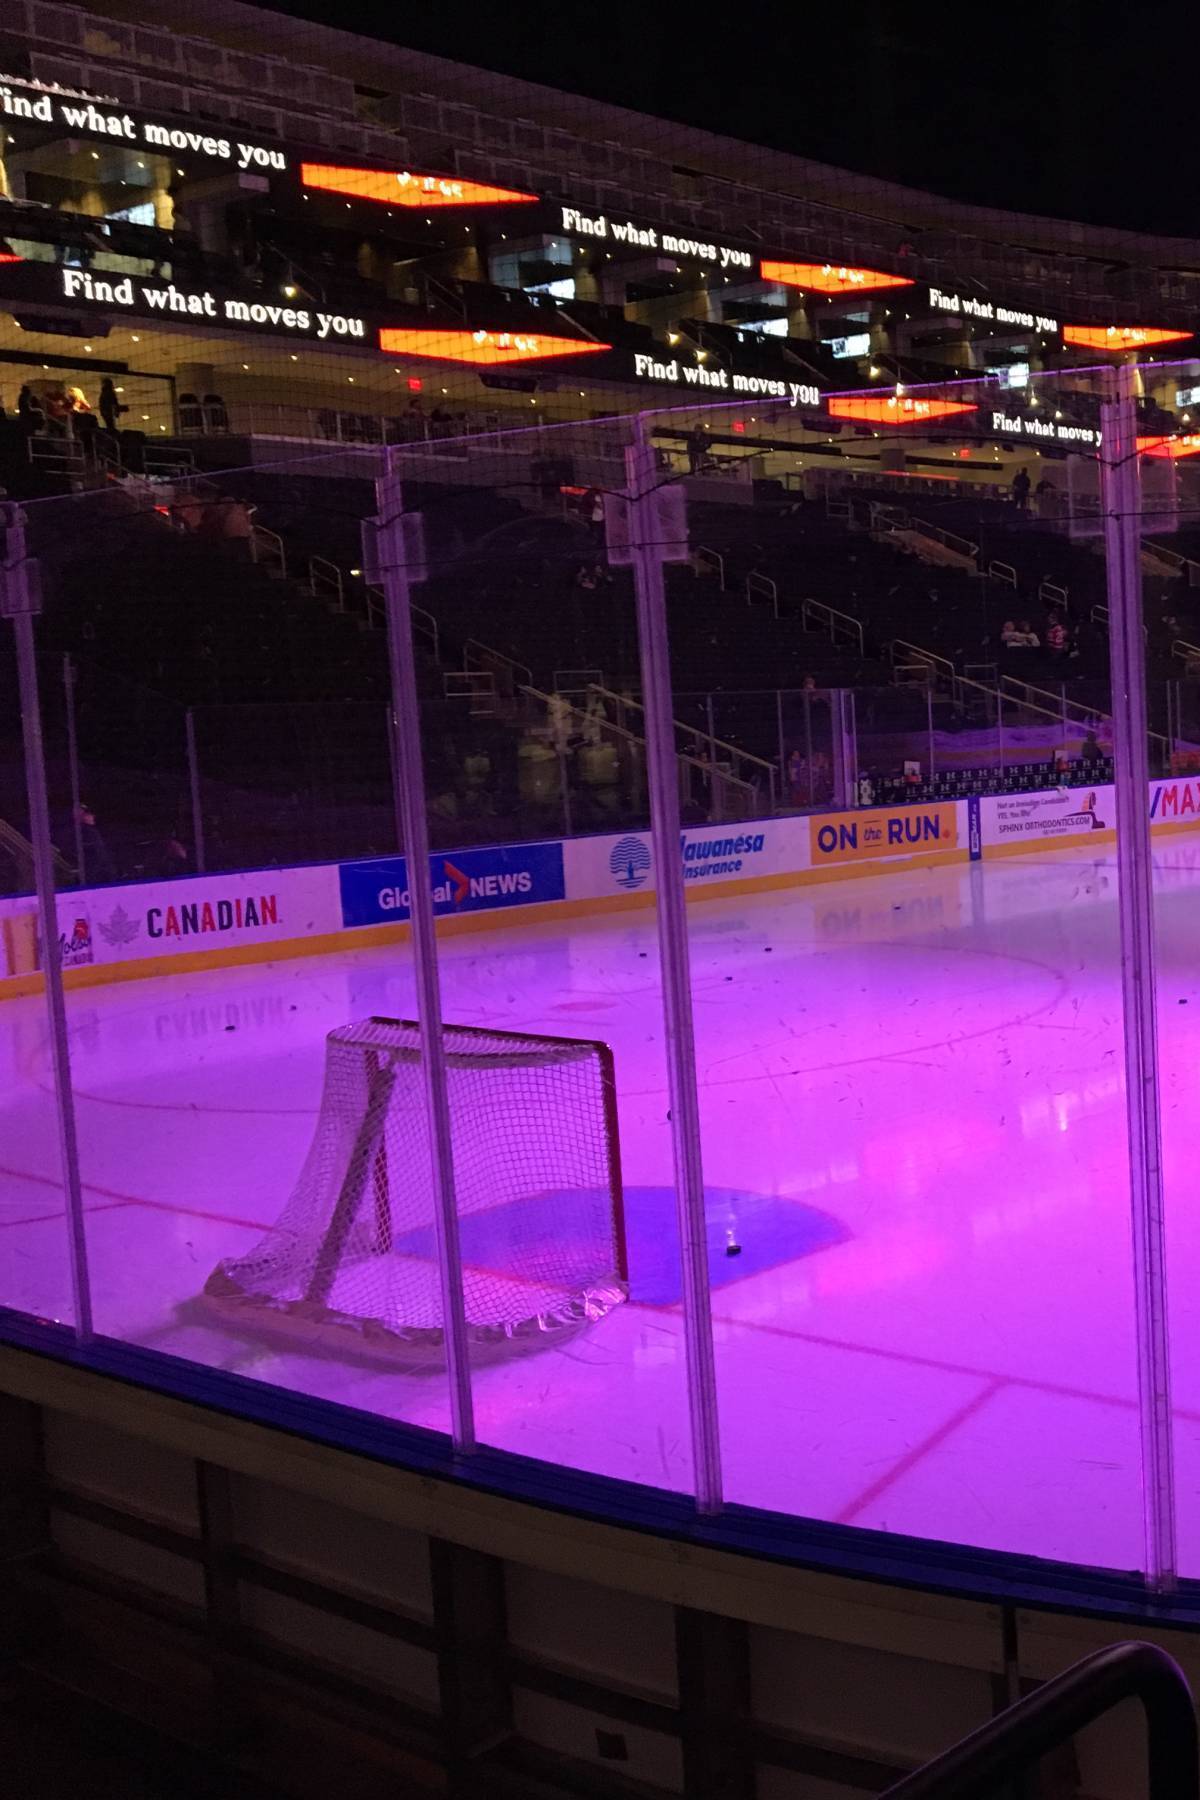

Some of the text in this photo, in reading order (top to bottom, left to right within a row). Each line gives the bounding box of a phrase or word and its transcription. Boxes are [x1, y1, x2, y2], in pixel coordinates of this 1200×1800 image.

[0, 86, 286, 169] ind what moves you
[562, 207, 751, 267] Find what moves you
[63, 269, 364, 338] Find what moves you
[930, 288, 1057, 333] Find what moves you
[635, 354, 820, 407] Find what moves you
[993, 413, 1021, 432] Find
[1024, 419, 1055, 437] what
[1058, 426, 1093, 442] moves
[681, 834, 765, 862] awanesa
[818, 823, 857, 853] ON
[864, 828, 882, 841] the
[888, 814, 940, 844] RUN
[378, 871, 532, 910] Gloal NEWS
[147, 895, 277, 938] CANADIAN
